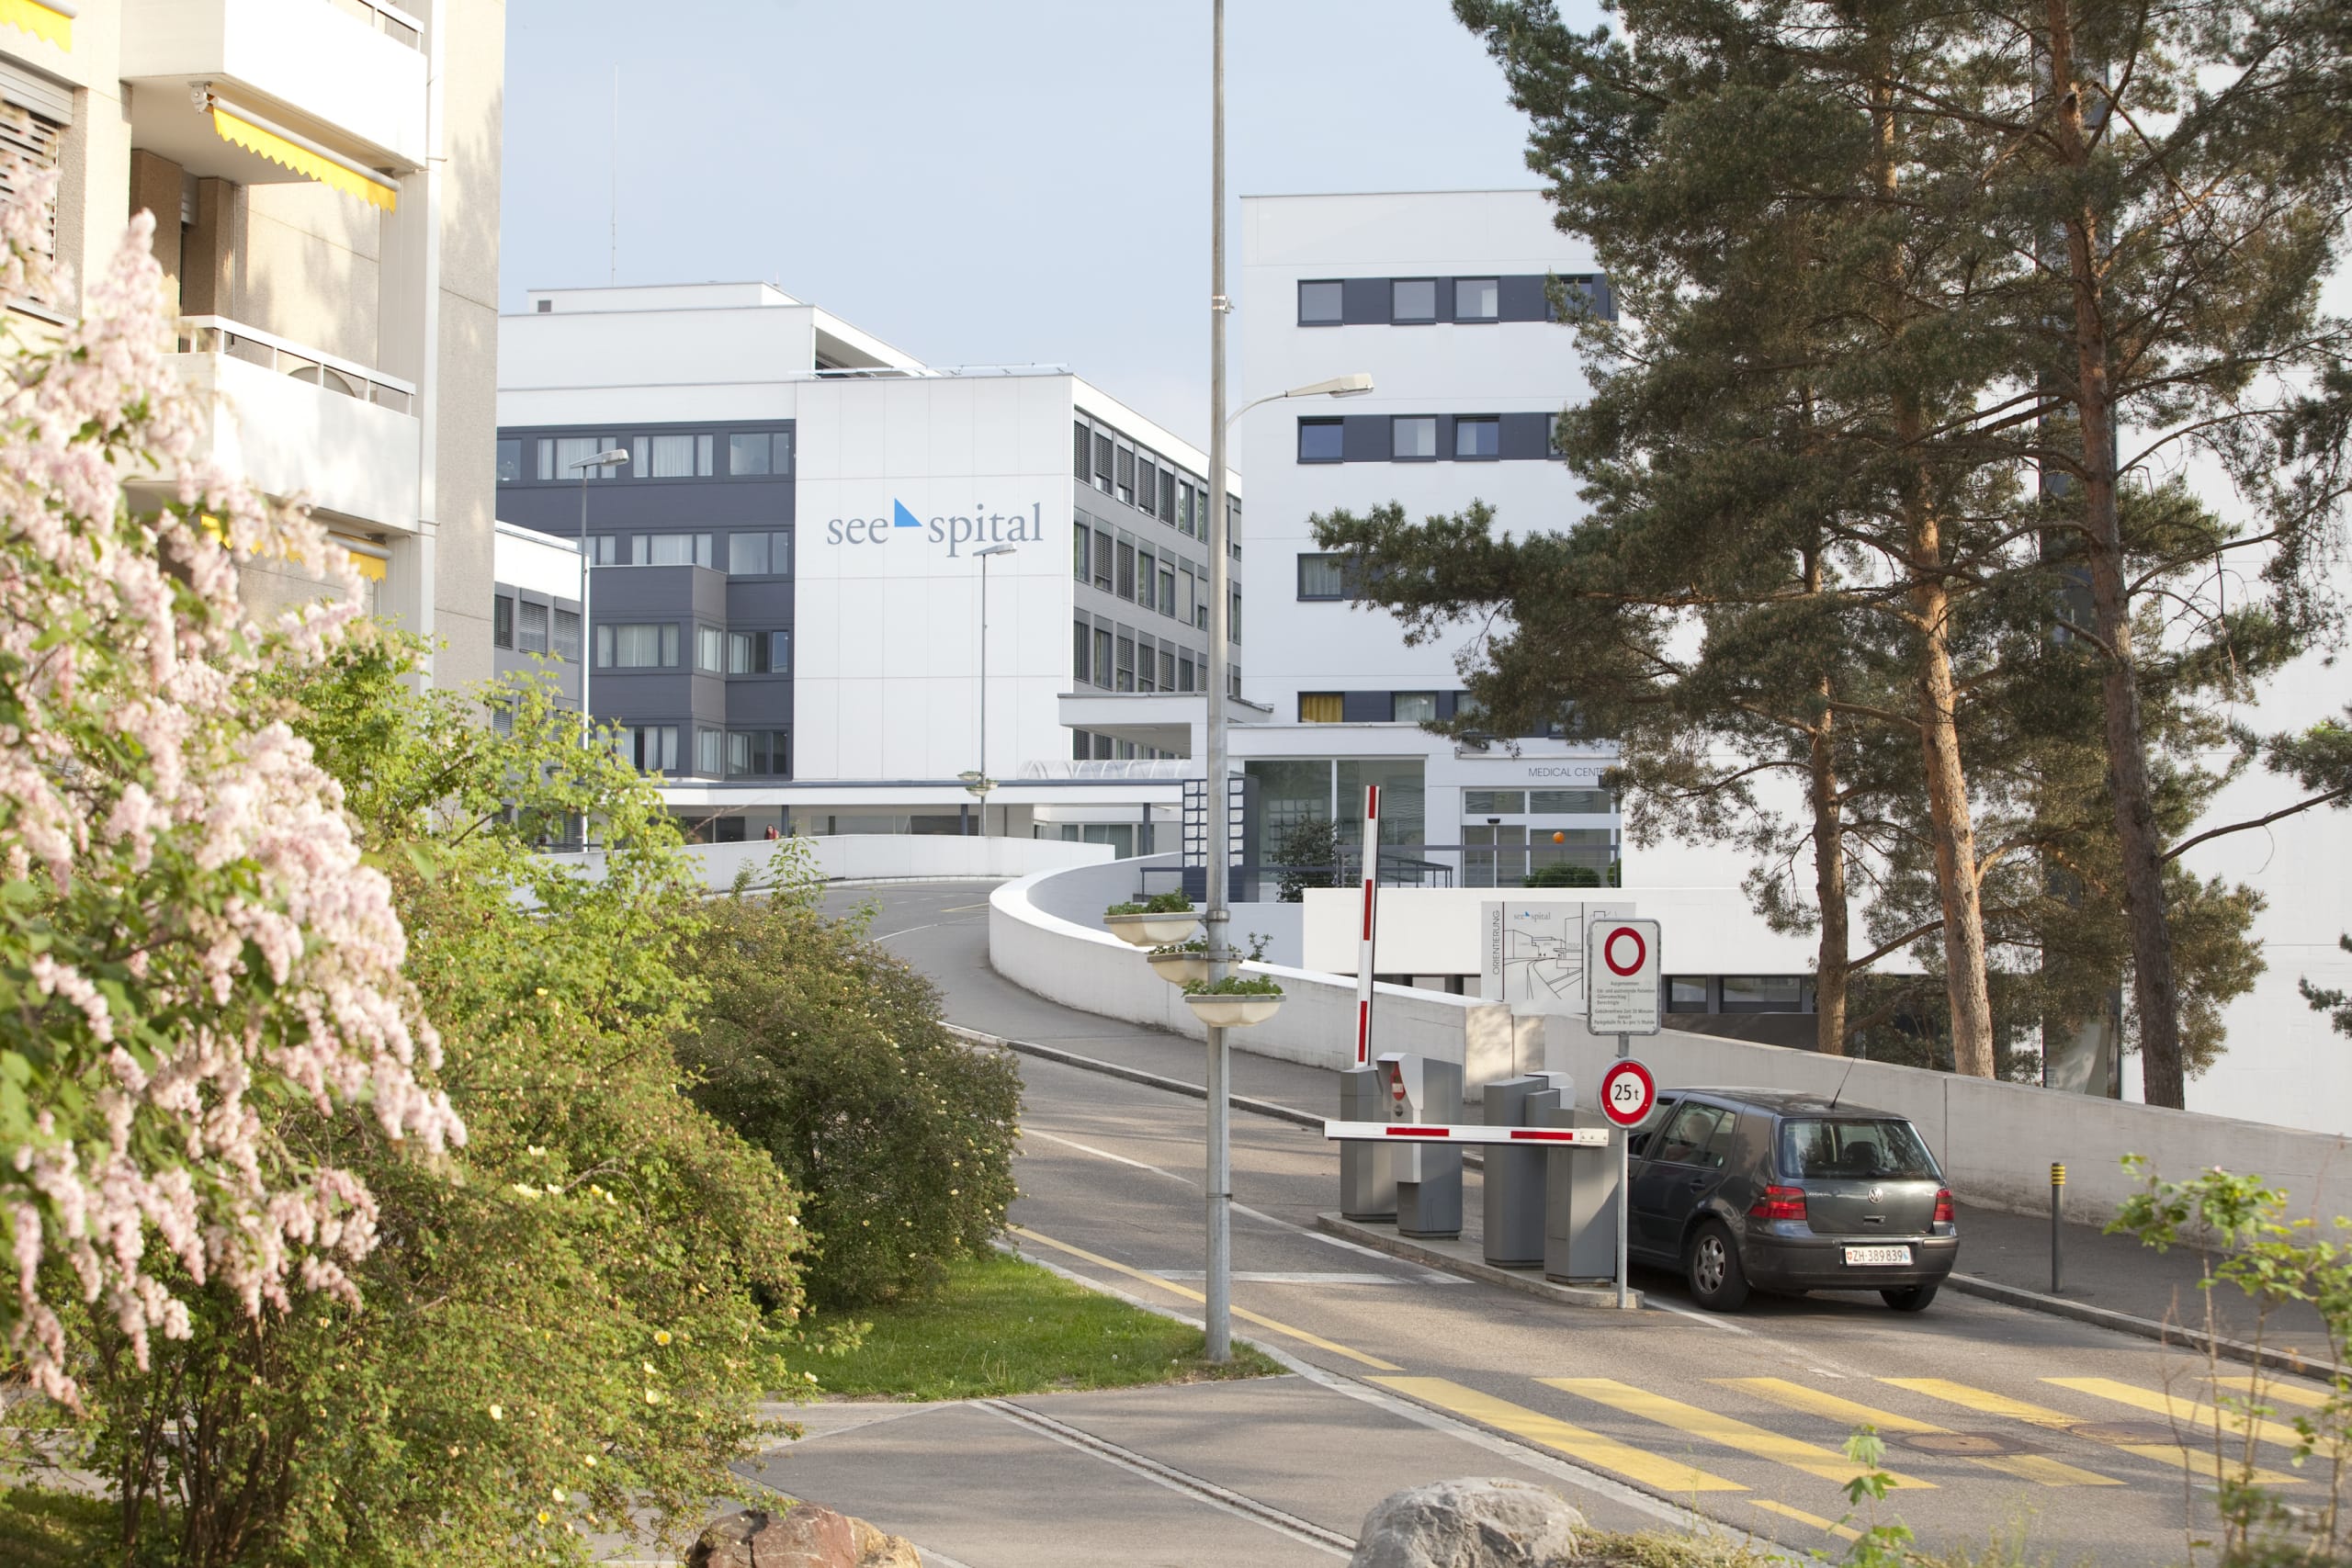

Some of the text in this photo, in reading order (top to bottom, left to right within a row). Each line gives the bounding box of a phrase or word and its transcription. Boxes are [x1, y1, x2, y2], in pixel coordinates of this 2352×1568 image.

[827, 502, 1044, 558] see spital
[1528, 767, 1572, 777] MEDICAL
[1492, 909, 1500, 976] ORIENTIERUNG
[1614, 1084, 1640, 1100] 25 t
